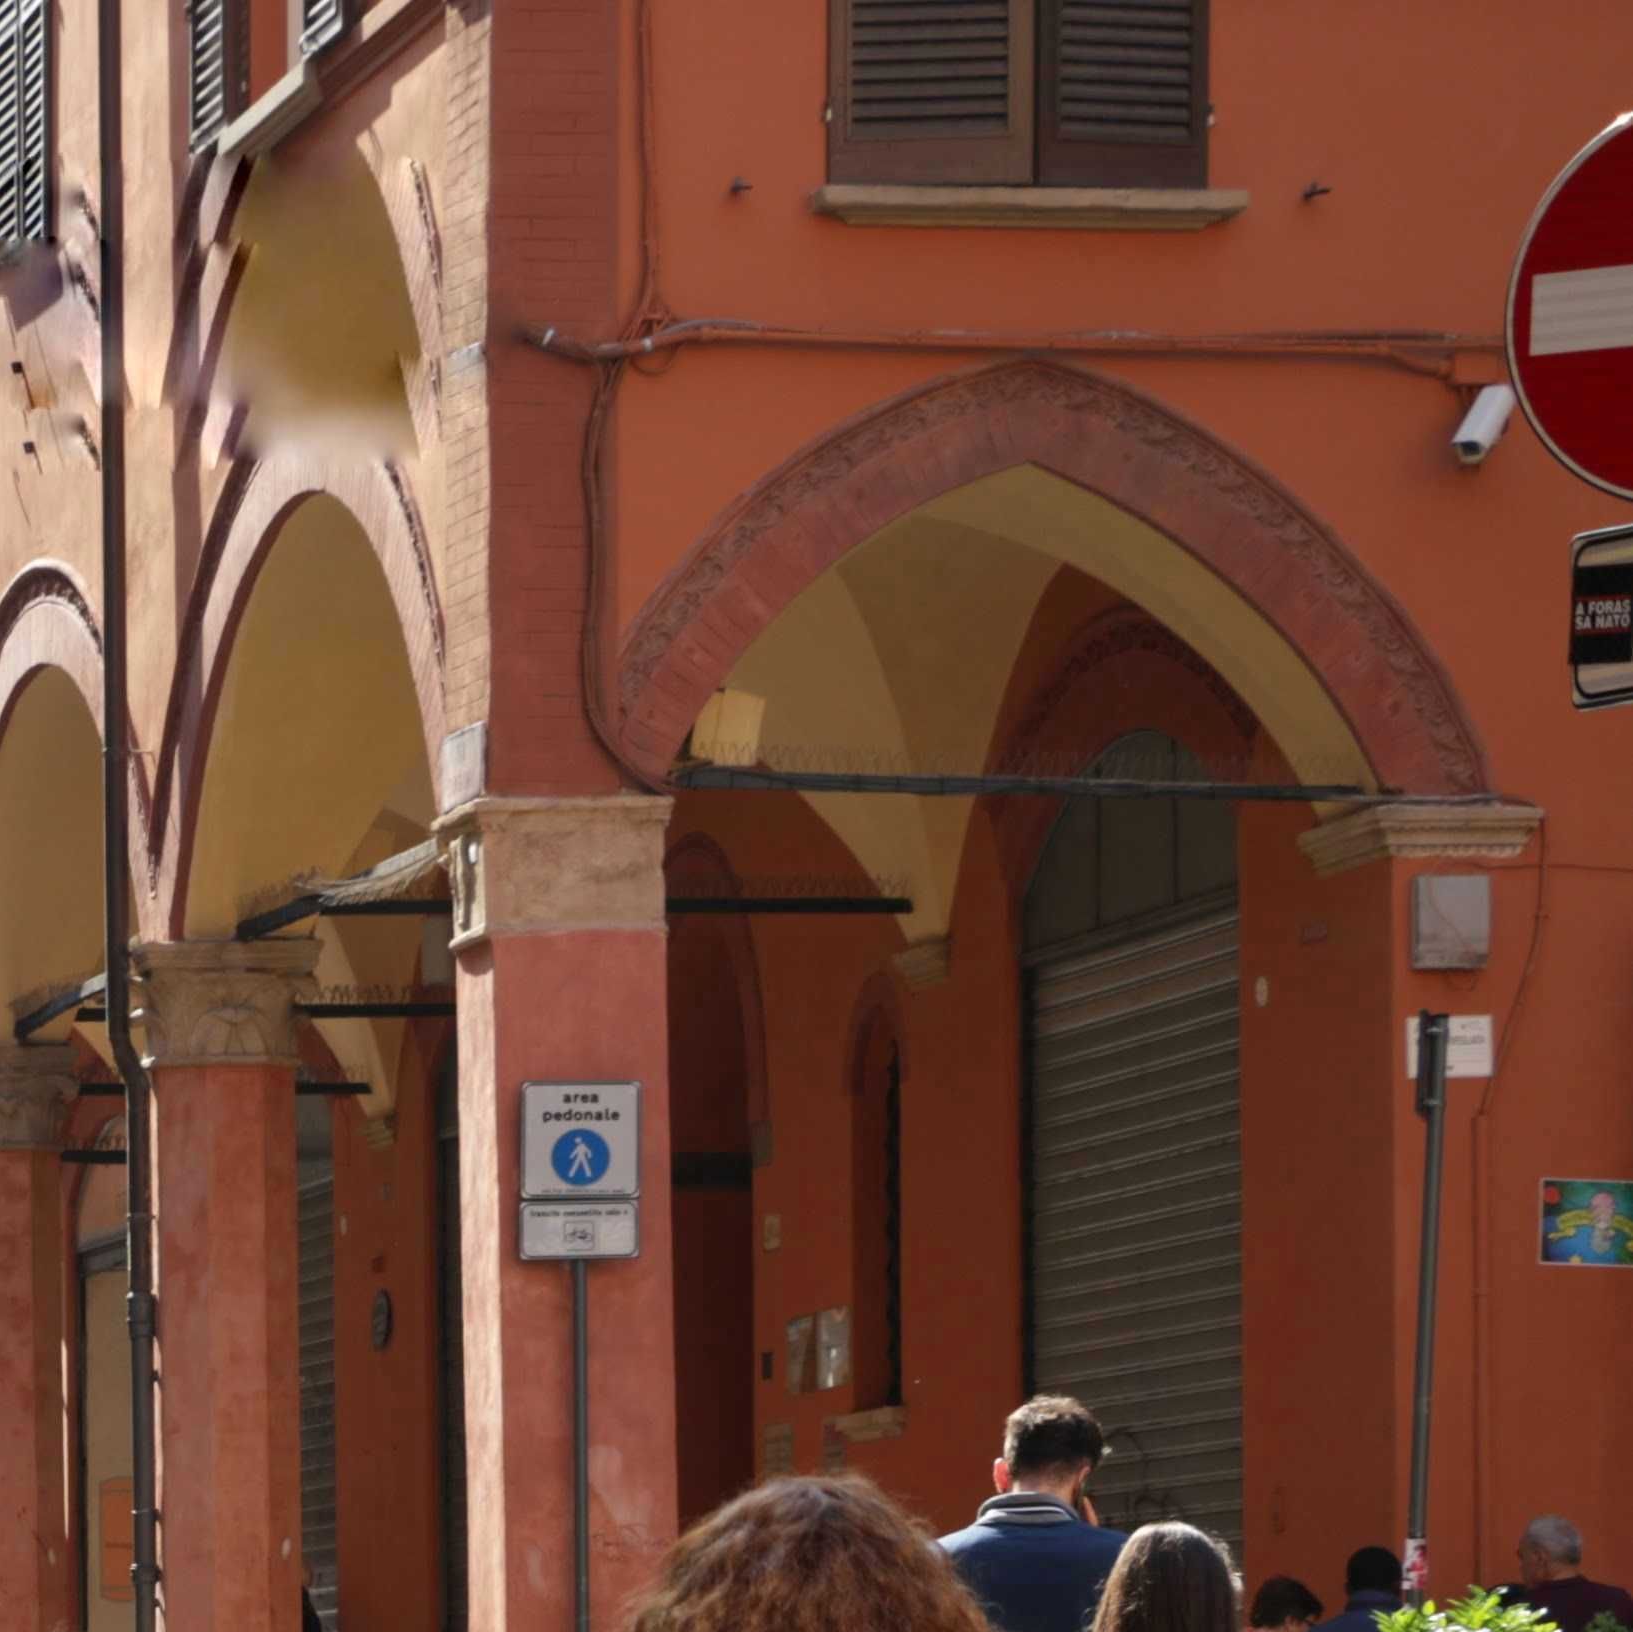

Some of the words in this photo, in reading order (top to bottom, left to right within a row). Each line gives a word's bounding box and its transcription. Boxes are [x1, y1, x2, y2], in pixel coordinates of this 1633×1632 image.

[1575, 601, 1584, 616] A
[1588, 599, 1631, 615] FORAS
[1575, 615, 1592, 630] SA
[1595, 613, 1631, 629] NATO
[563, 1093, 599, 1104] area
[542, 1108, 620, 1123] pedonale
